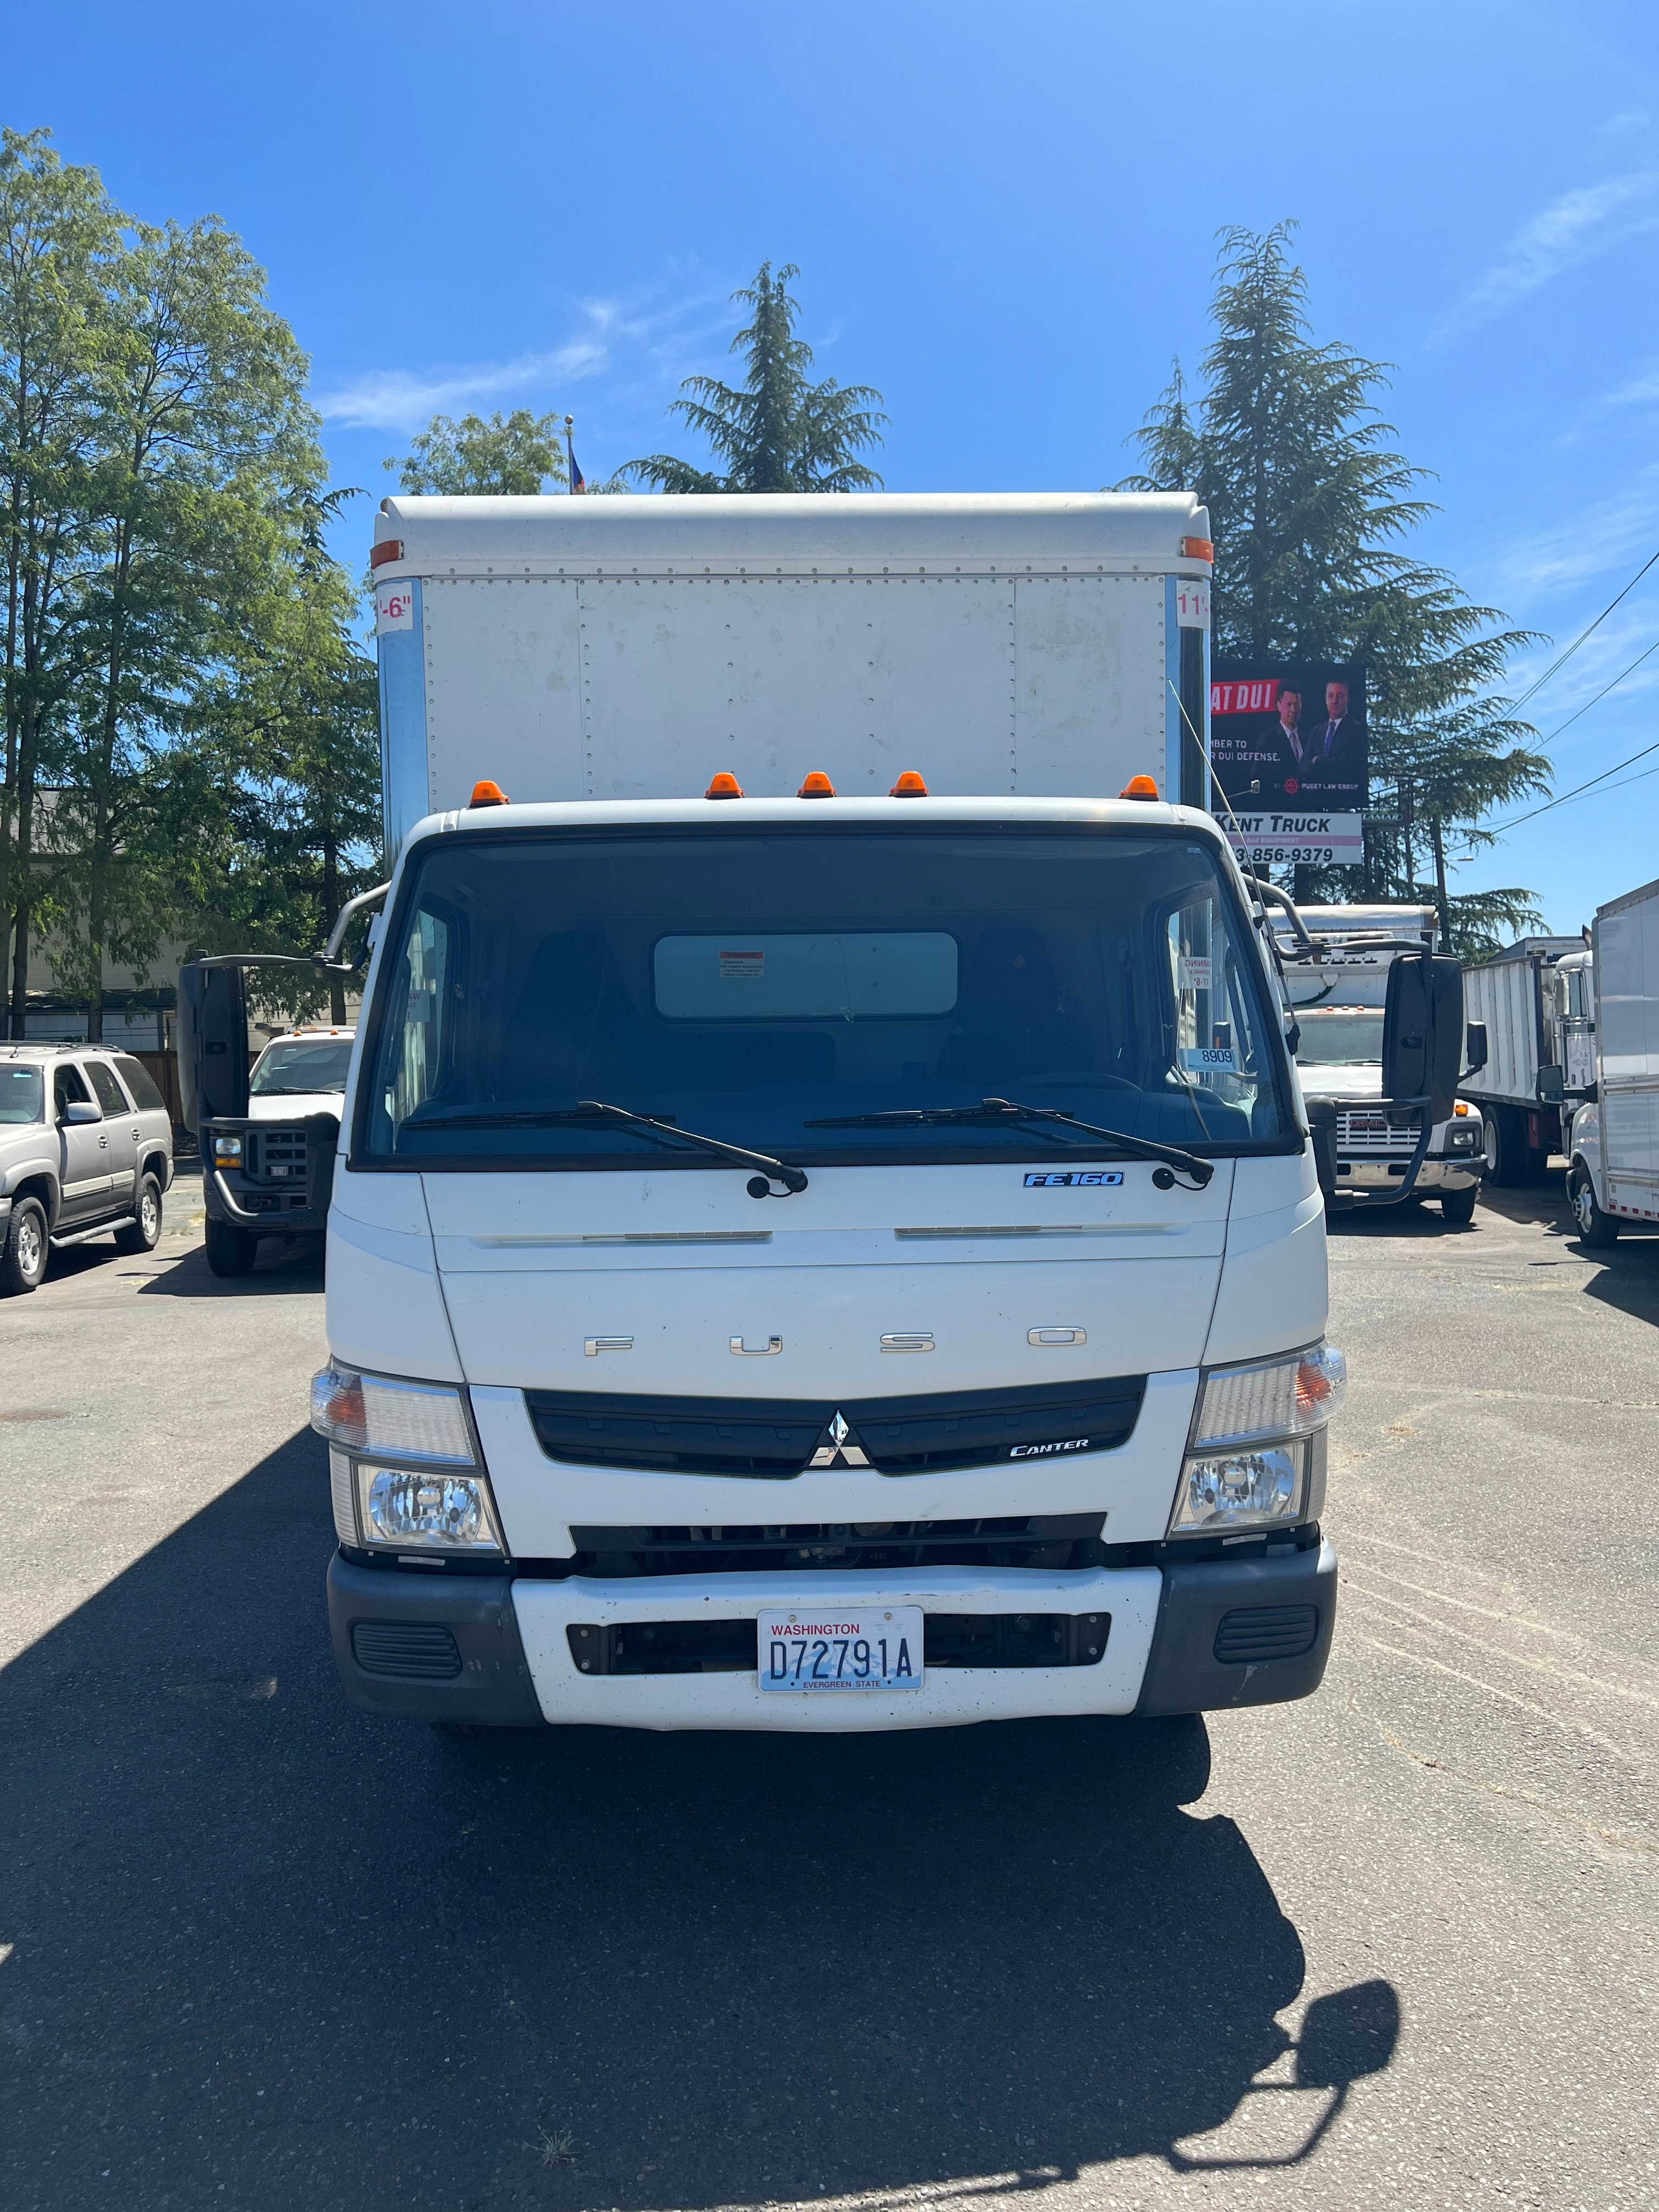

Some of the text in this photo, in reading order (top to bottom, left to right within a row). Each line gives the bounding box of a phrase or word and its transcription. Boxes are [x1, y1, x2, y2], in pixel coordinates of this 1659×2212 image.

[1236, 684, 1271, 710] DUI
[1235, 740, 1247, 748] TO
[1218, 752, 1234, 760] DUI
[1237, 753, 1280, 761] DEFENSE.
[1215, 815, 1331, 833] KENT TRUCK
[1202, 1050, 1232, 1063] 8909
[1350, 1119, 1387, 1128] GMC
[584, 1325, 1087, 1357] FUSO
[1009, 1439, 1090, 1458] CANTER
[771, 1624, 860, 1635] WASHINGTON
[770, 1638, 912, 1680] D72791A
